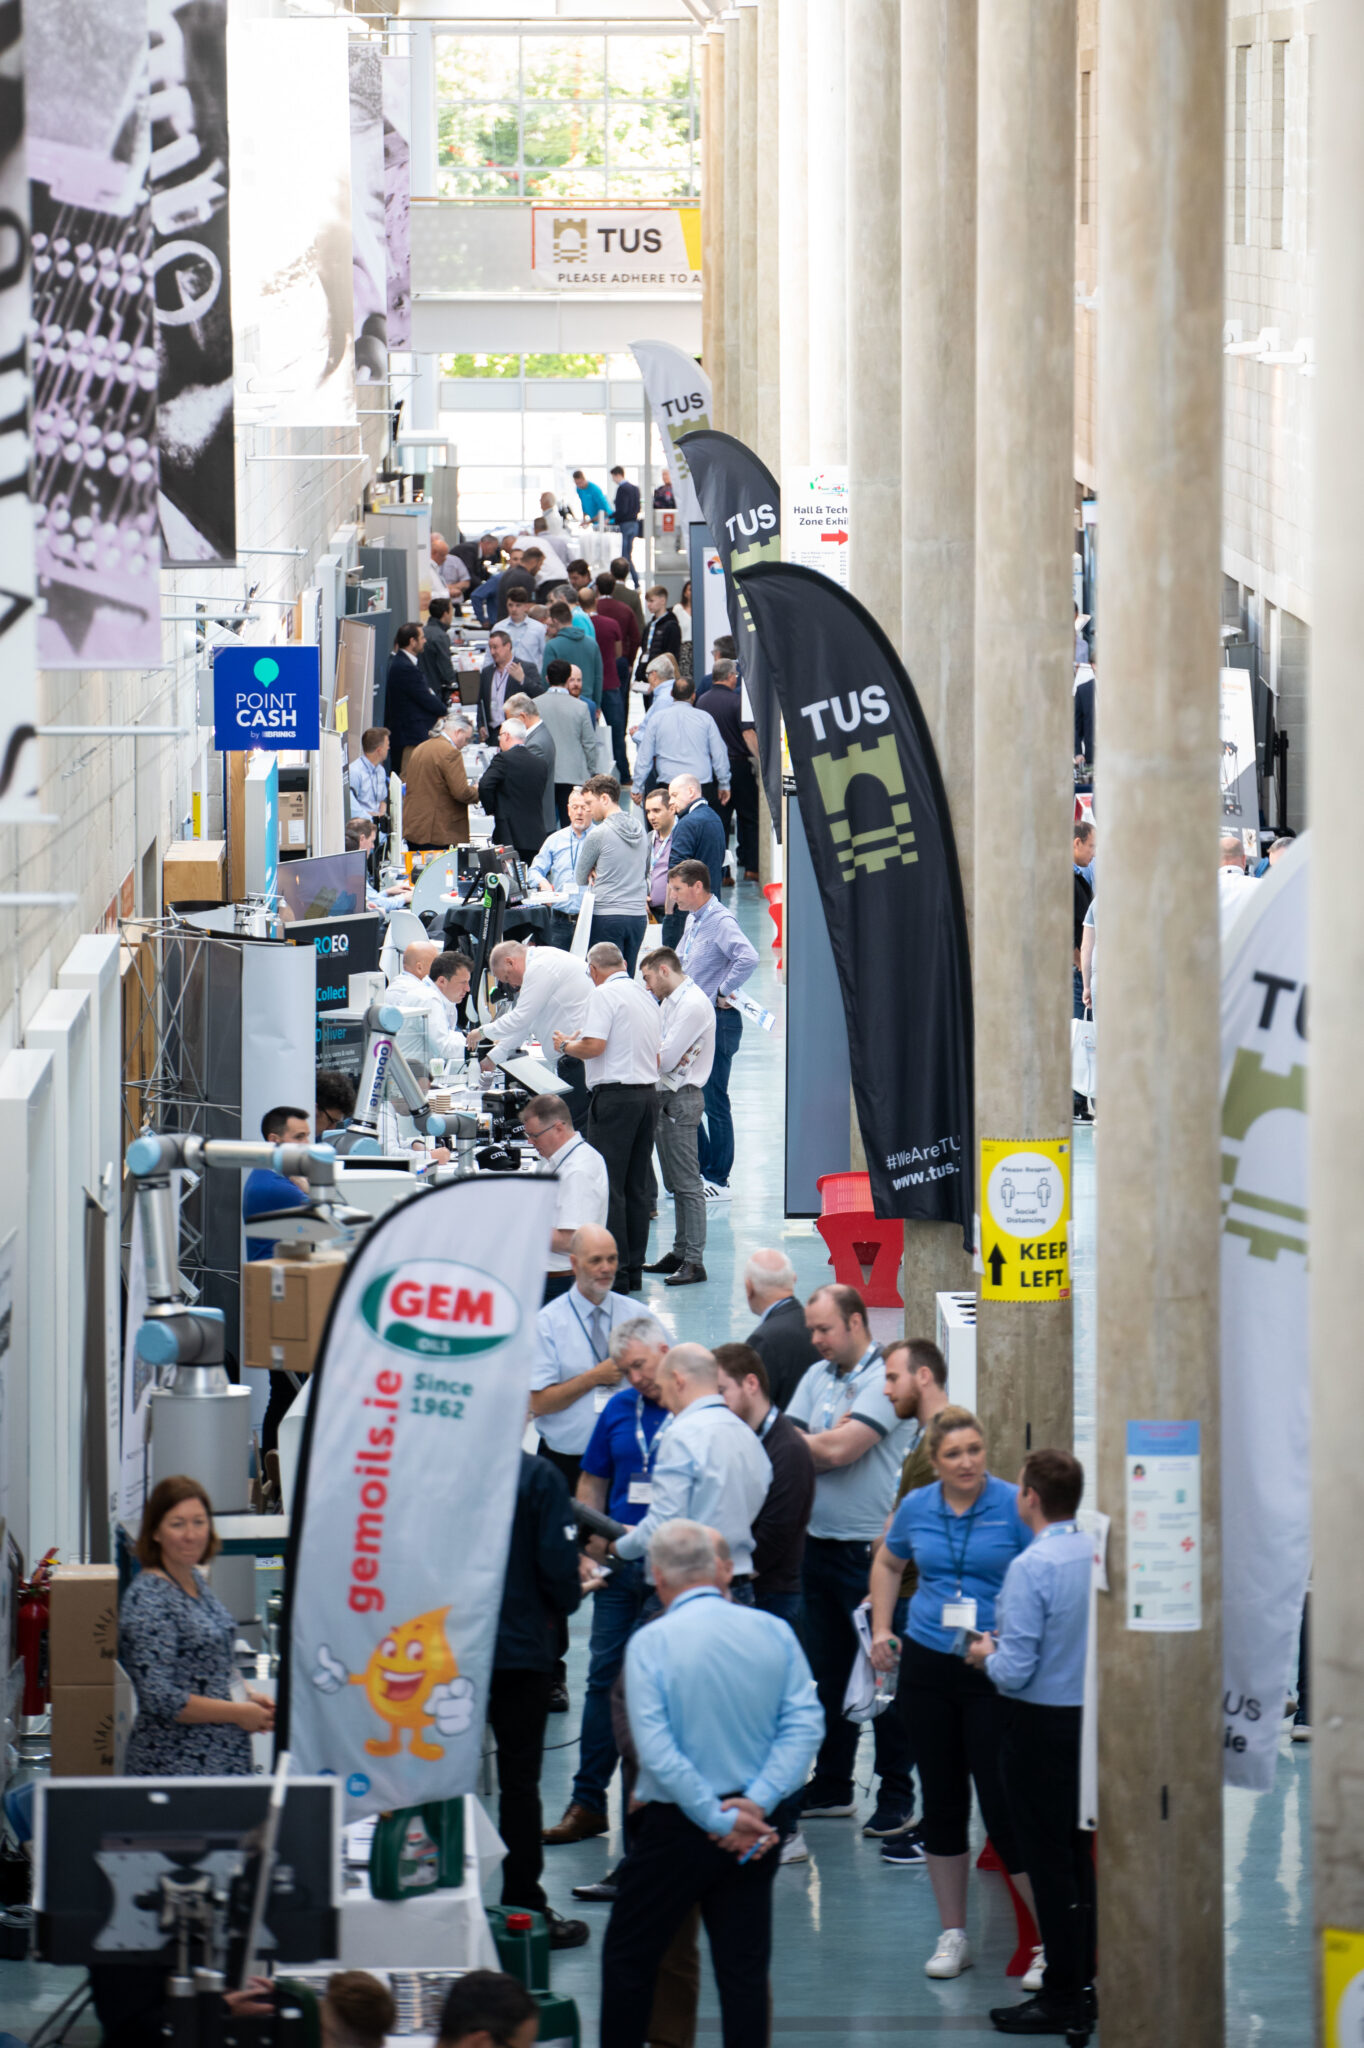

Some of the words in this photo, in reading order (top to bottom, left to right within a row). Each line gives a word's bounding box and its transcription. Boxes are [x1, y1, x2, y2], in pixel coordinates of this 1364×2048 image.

[597, 228, 662, 253] TUS
[558, 273, 606, 283] PLEASE
[611, 273, 665, 283] ADHERE
[670, 274, 688, 283] TO
[661, 392, 704, 418] TUS
[793, 506, 813, 514] Hall
[815, 506, 823, 514] &
[826, 506, 848, 514] Tech
[725, 503, 777, 543] TUS
[799, 517, 824, 526] Zone
[826, 517, 848, 526] Exhi
[236, 693, 296, 709] POINT
[236, 709, 297, 727] CASH
[800, 684, 891, 742] TUS
[250, 731, 260, 739] by
[314, 934, 349, 954] ROEQ
[316, 985, 347, 1002] Collect
[1006, 1217, 1046, 1225] Distancing
[1015, 1208, 1037, 1216] Social
[1020, 1241, 1067, 1260] KEEP
[1020, 1269, 1064, 1288] LEFT
[390, 1280, 493, 1326] GEM
[414, 1372, 473, 1396] Since
[410, 1397, 465, 1419] 1962
[347, 1369, 403, 1614] gemoils.ie
